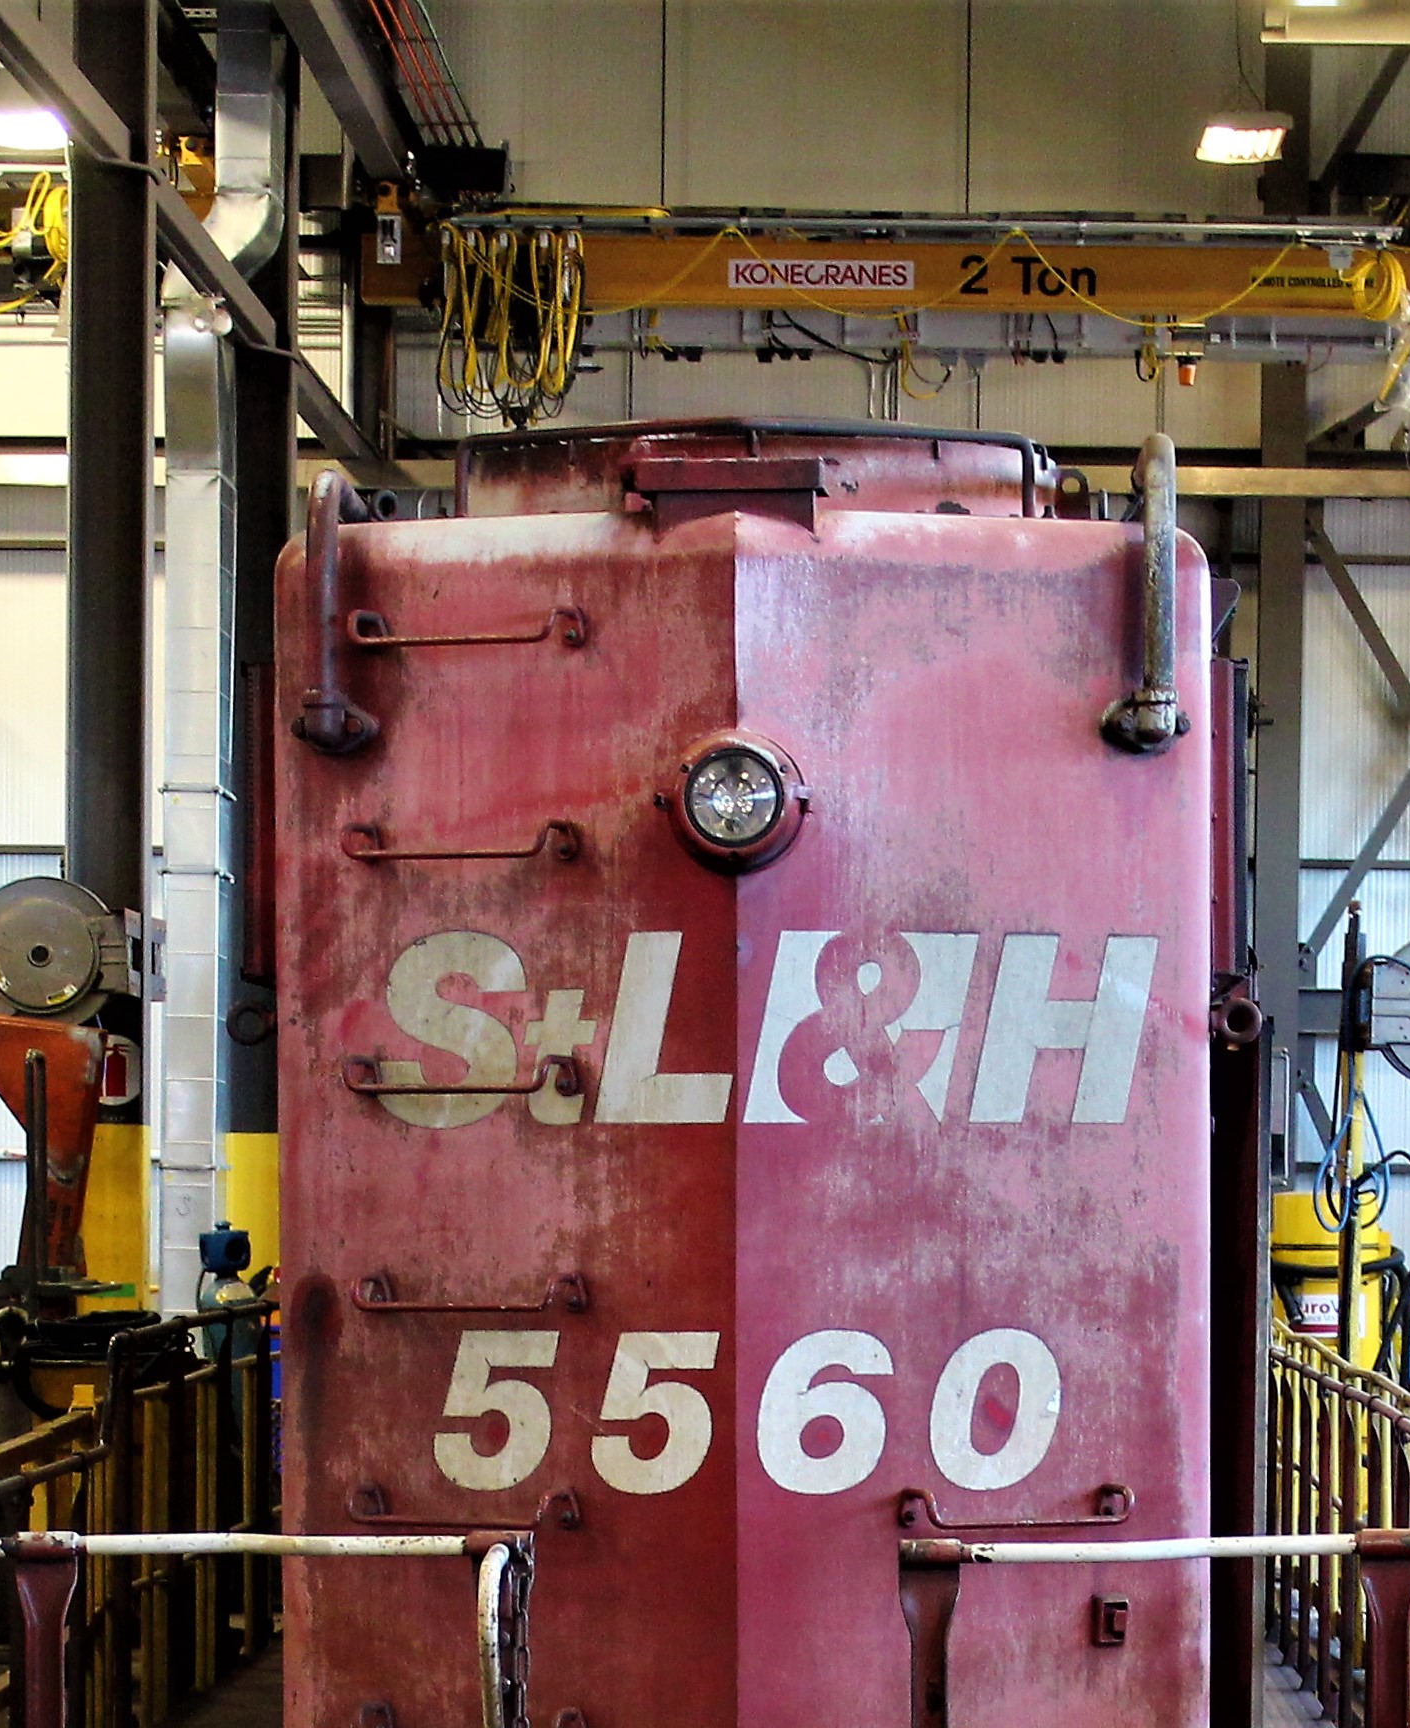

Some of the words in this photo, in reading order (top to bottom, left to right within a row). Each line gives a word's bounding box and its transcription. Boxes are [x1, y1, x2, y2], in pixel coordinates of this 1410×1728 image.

[734, 264, 908, 286] KONECRANES
[959, 255, 989, 295] 2
[1011, 256, 1097, 297] Ton
[433, 1327, 1062, 1495] 5560
